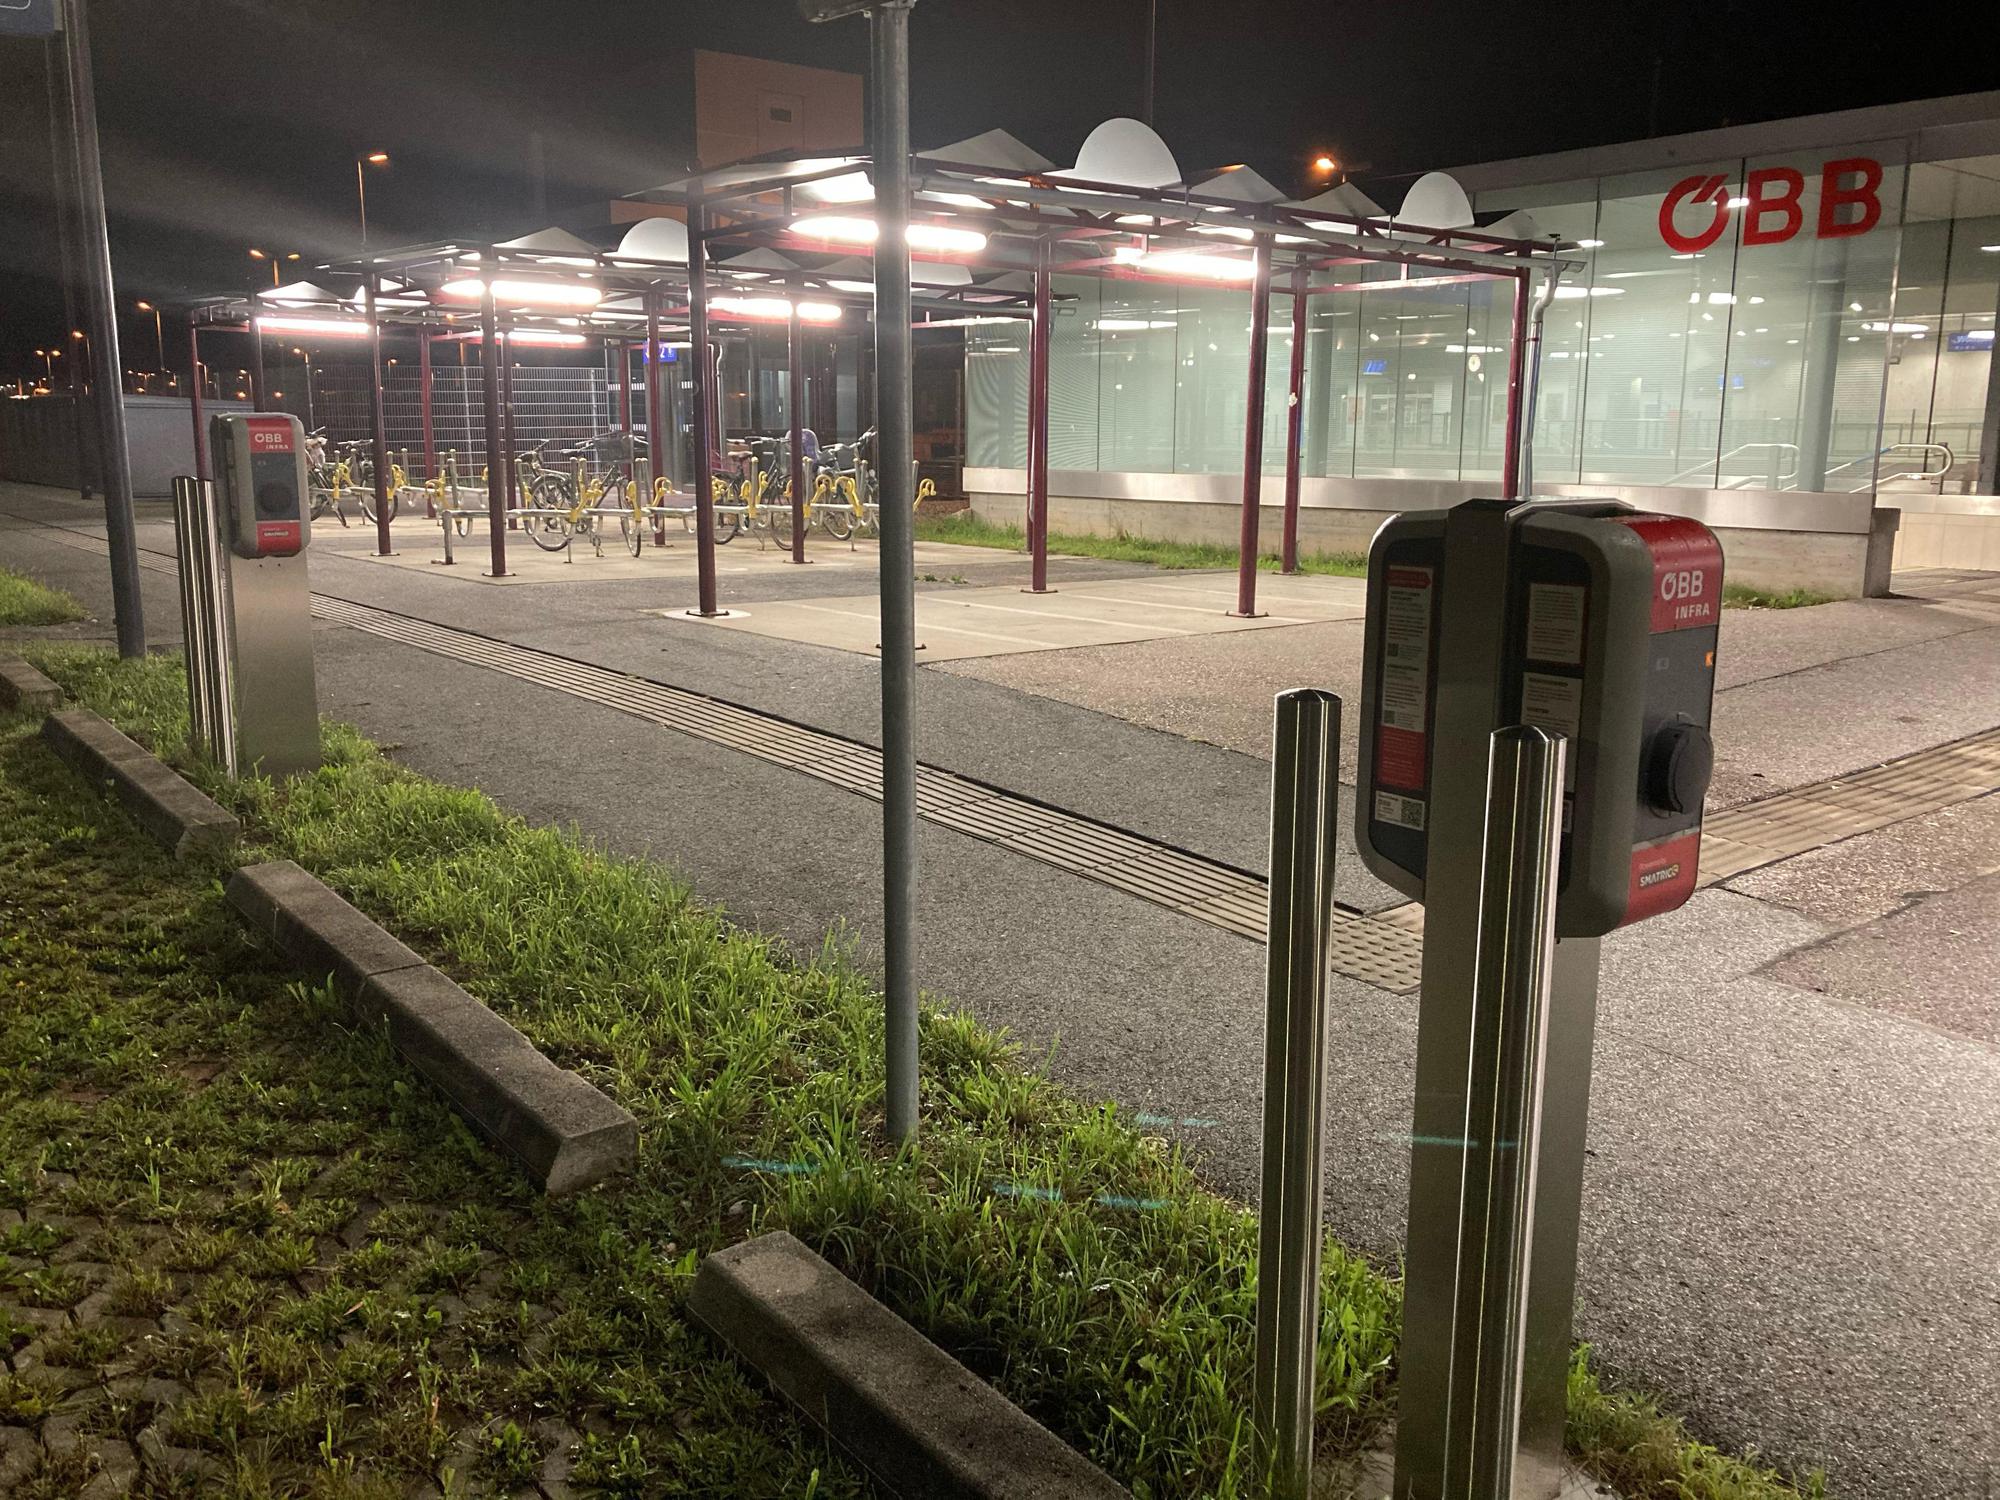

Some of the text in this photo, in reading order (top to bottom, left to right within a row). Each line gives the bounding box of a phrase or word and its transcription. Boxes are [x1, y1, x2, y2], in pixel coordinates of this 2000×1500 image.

[1658, 157, 1884, 253] ÖBB
[254, 433, 282, 443] ÖBB
[1661, 570, 1703, 600] ÖBB
[1675, 602, 1710, 620] INFRA
